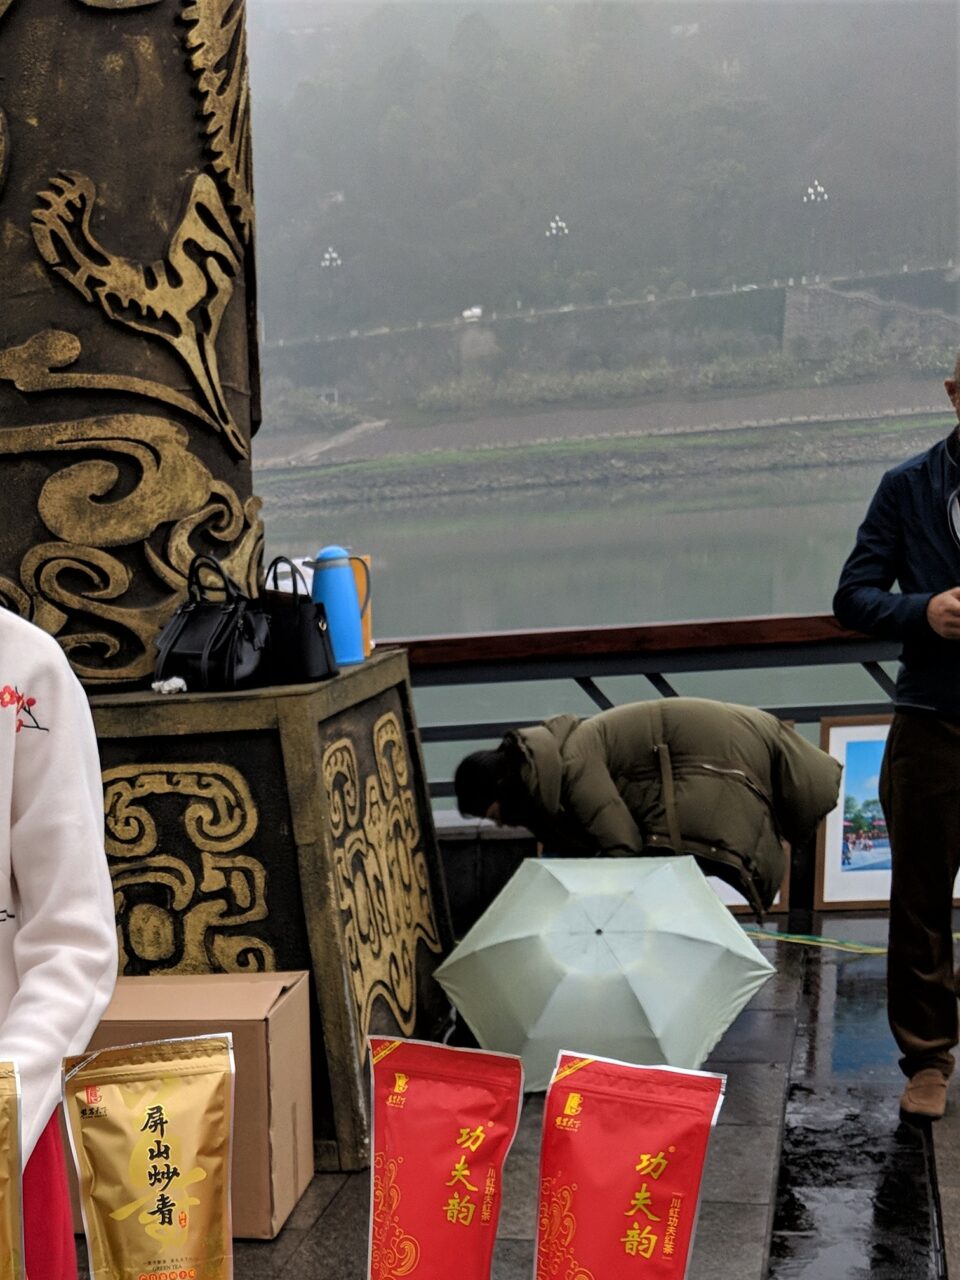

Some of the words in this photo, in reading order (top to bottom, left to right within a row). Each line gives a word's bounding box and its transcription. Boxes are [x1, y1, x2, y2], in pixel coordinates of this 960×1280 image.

[140, 1104, 180, 1226] 屏山炒青
[442, 1125, 487, 1226] 功夫韵
[620, 1151, 669, 1259] 功夫韵
